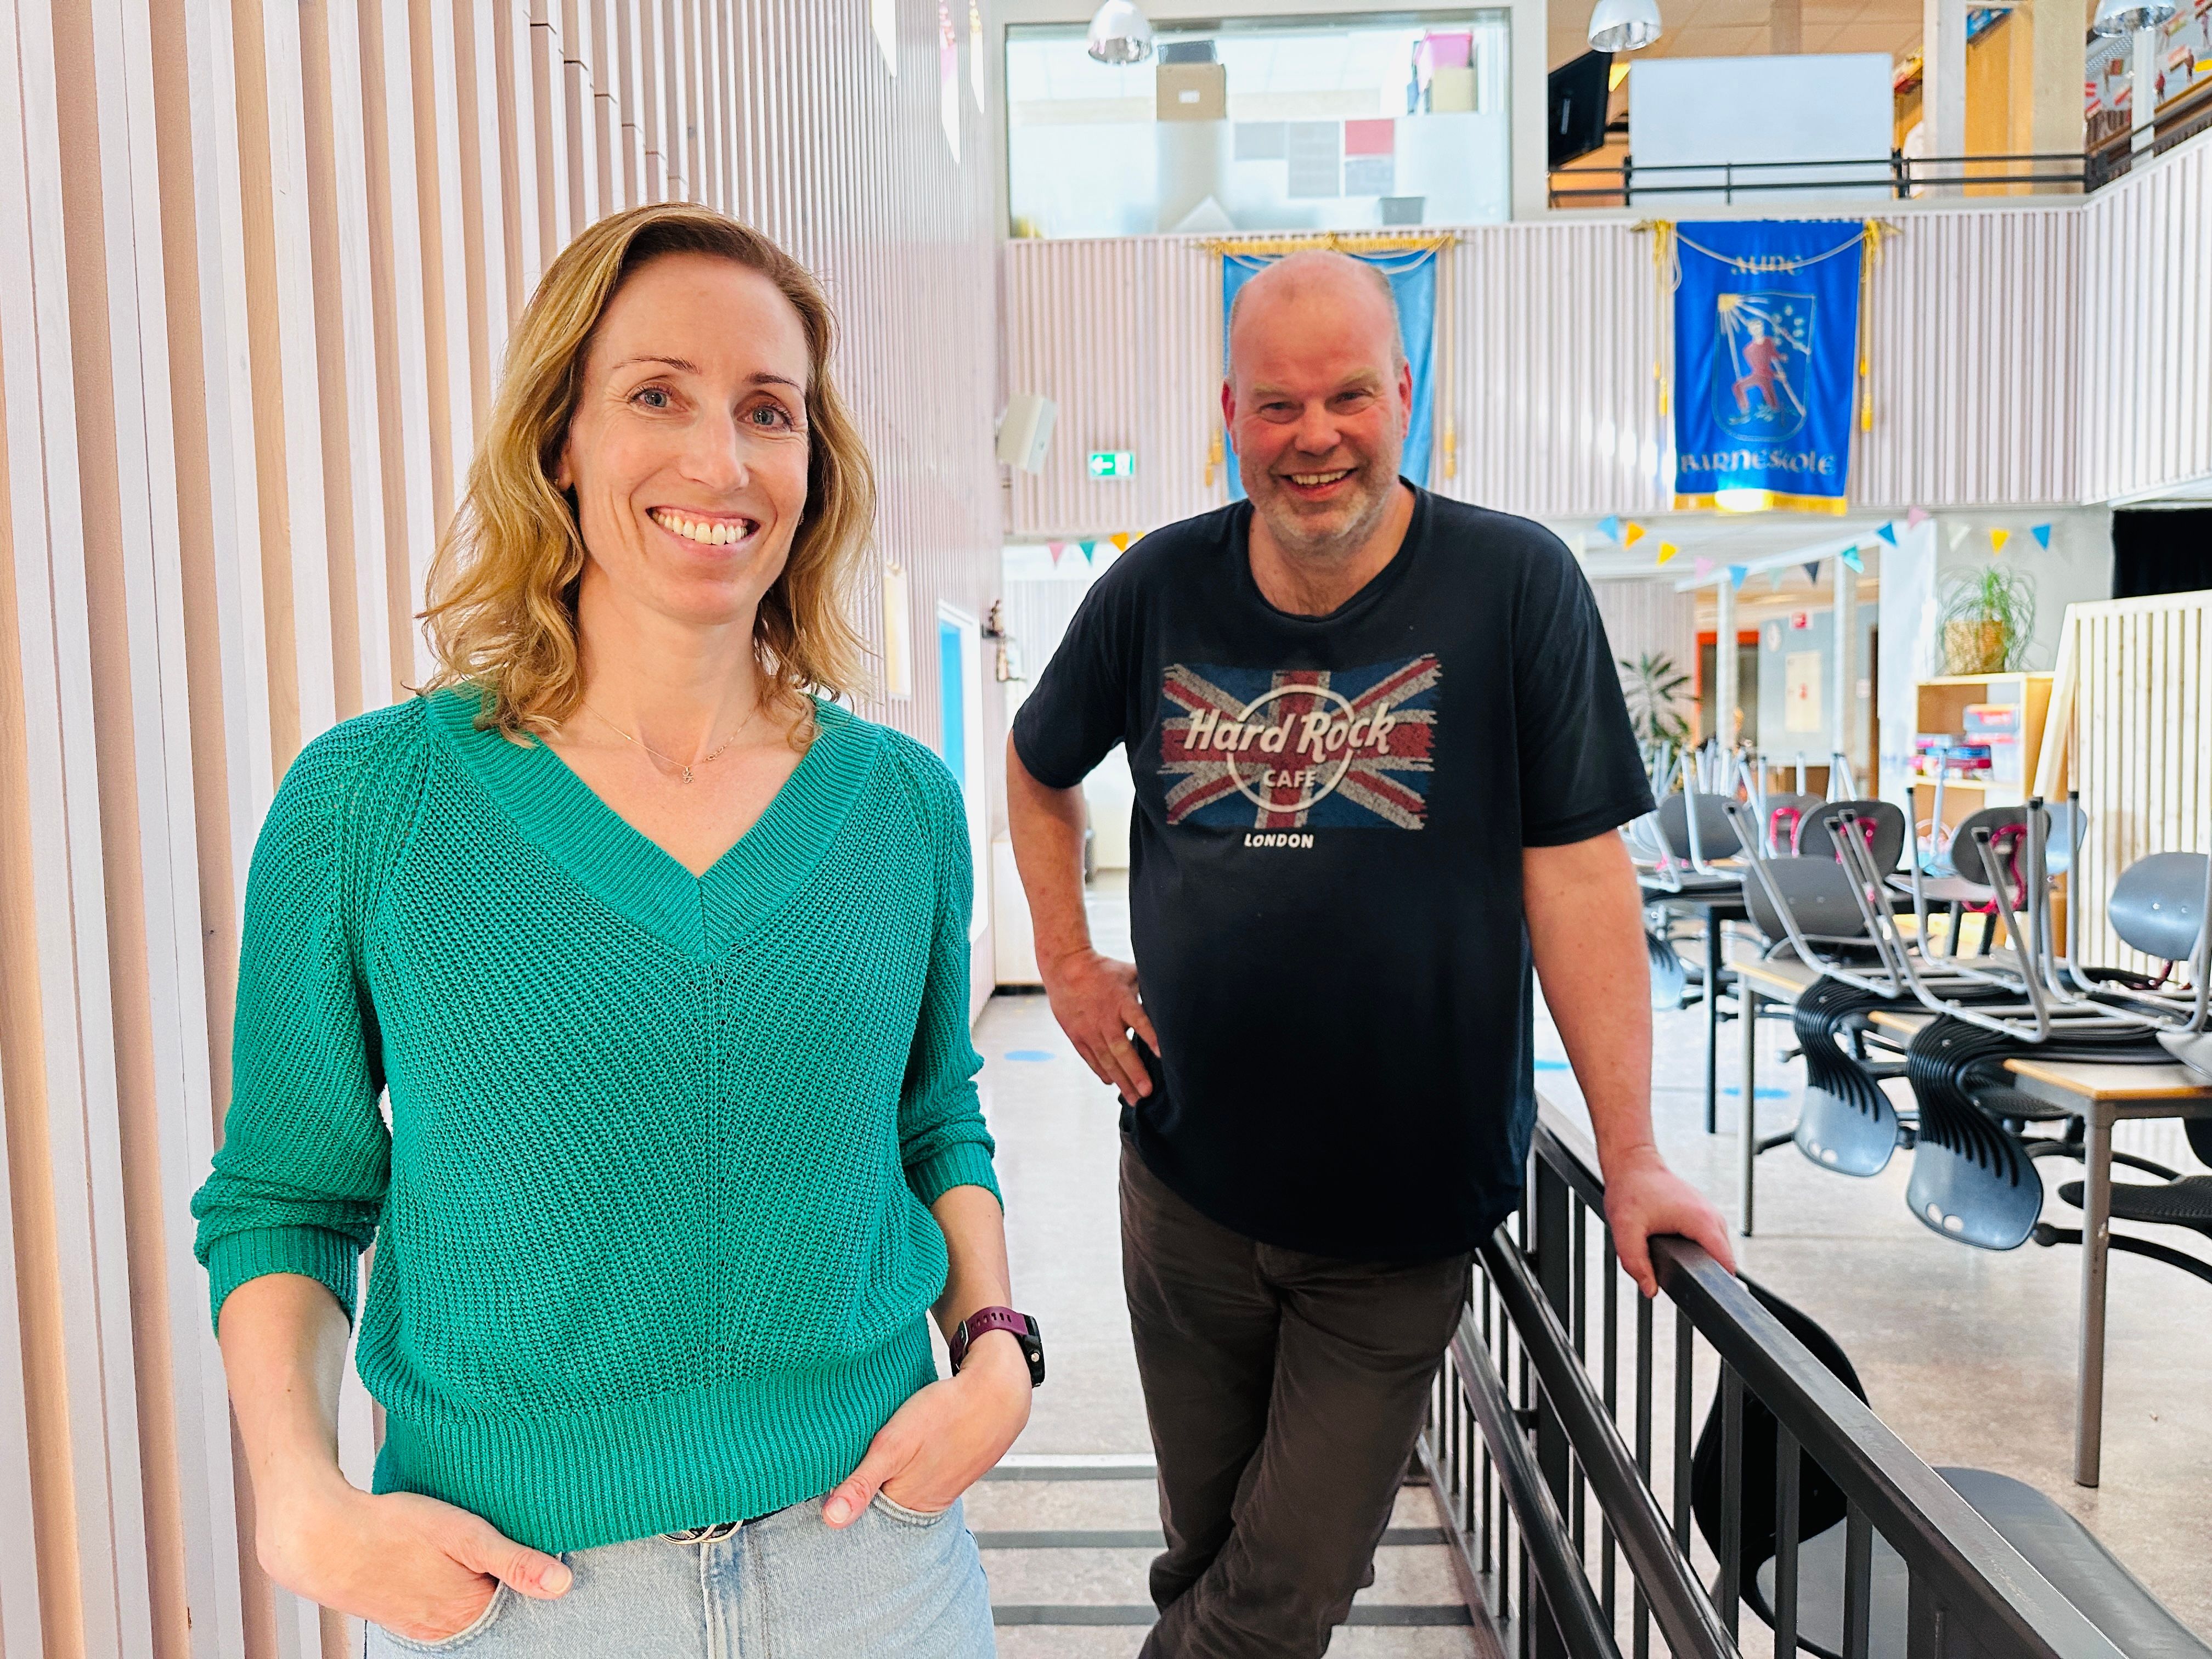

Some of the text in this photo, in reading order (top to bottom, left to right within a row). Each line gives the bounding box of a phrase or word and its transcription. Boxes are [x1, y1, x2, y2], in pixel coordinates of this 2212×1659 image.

[1184, 703, 1396, 763] Hard Rock
[1263, 769, 1316, 788] CAFE
[1244, 833, 1314, 849] LONDON
